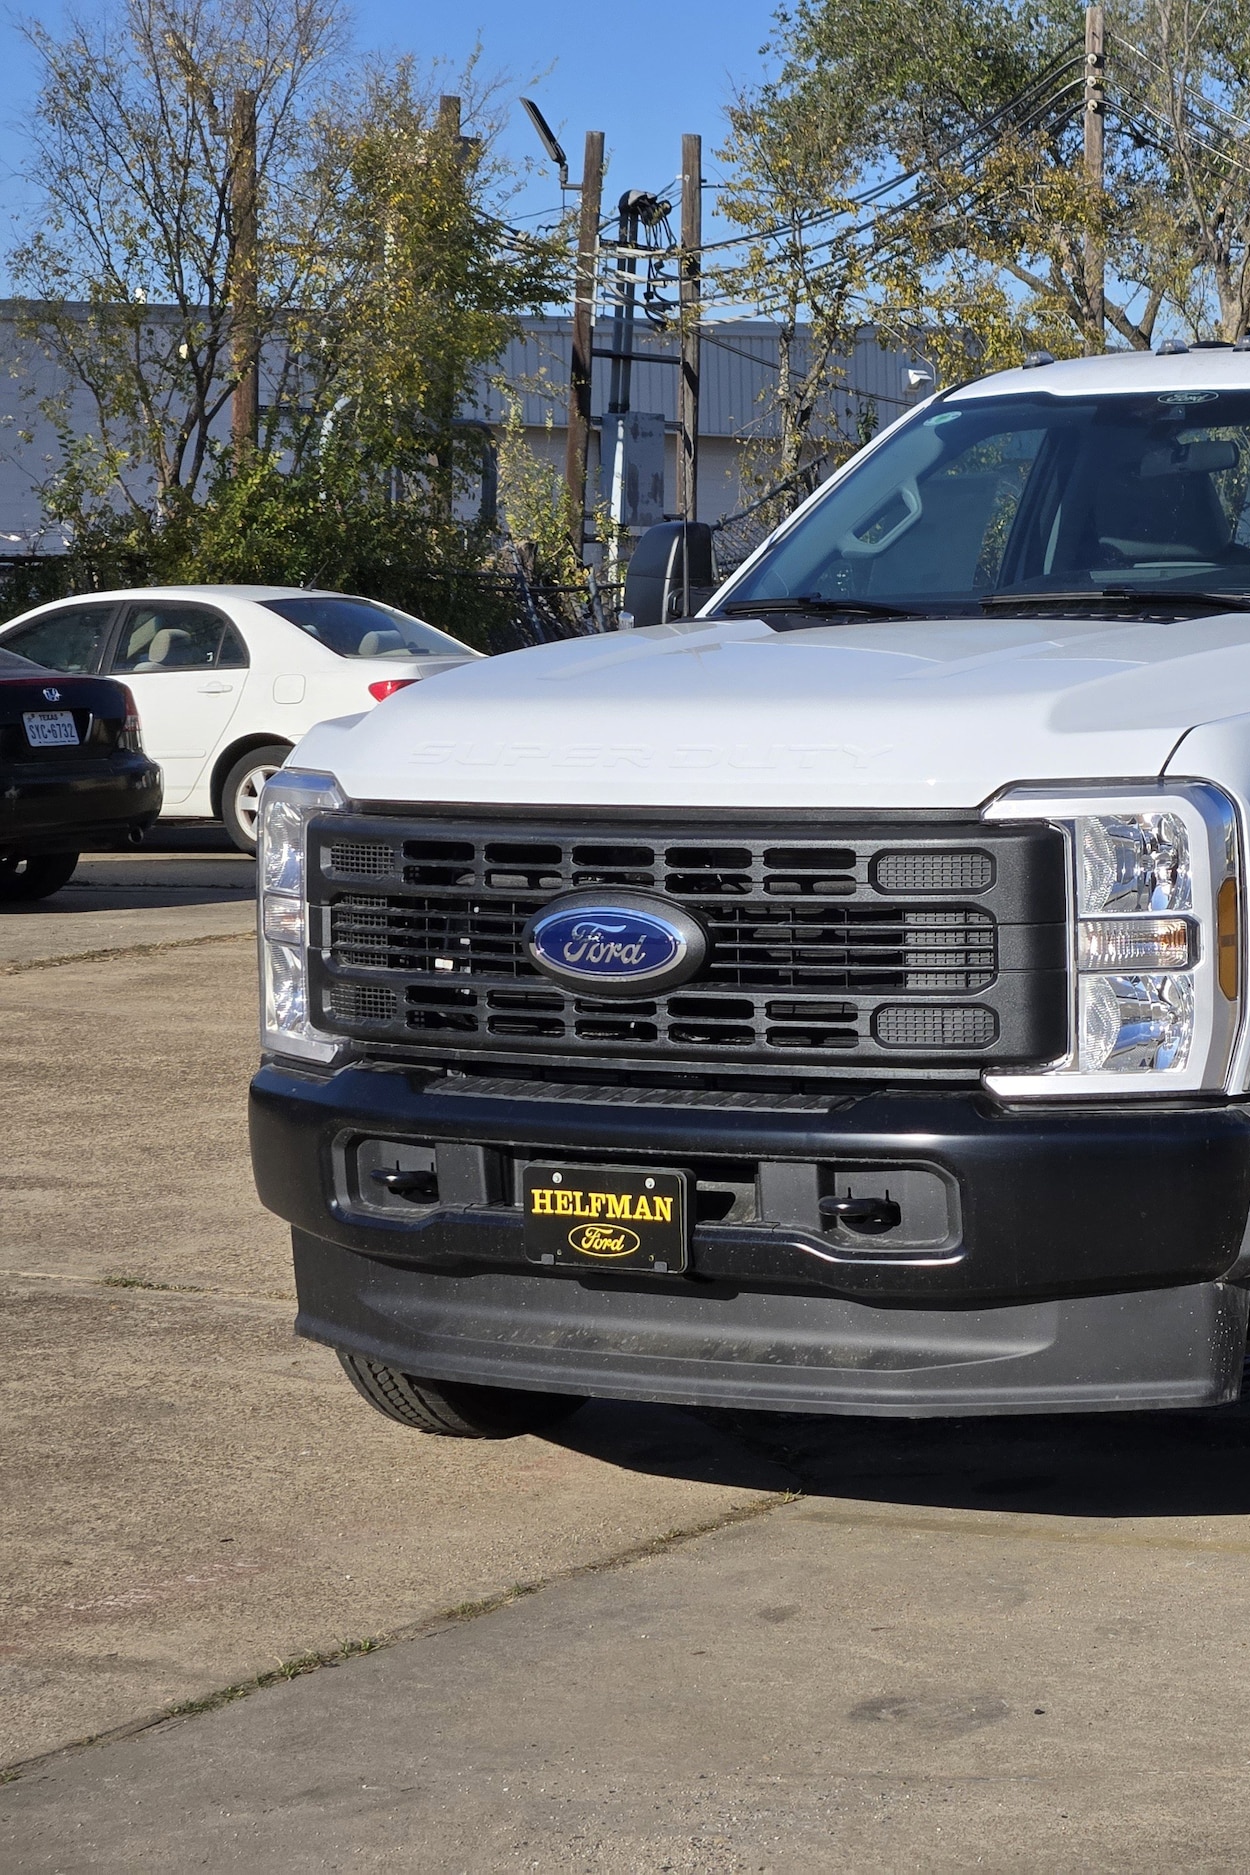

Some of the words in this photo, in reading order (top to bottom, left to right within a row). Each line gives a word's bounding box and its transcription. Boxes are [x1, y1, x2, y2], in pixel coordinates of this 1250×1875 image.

[408, 740, 657, 768] SUPER
[668, 744, 894, 769] DUTY
[563, 922, 647, 964] Ford
[531, 1189, 673, 1222] HELFMAN
[581, 1226, 626, 1251] Ford
